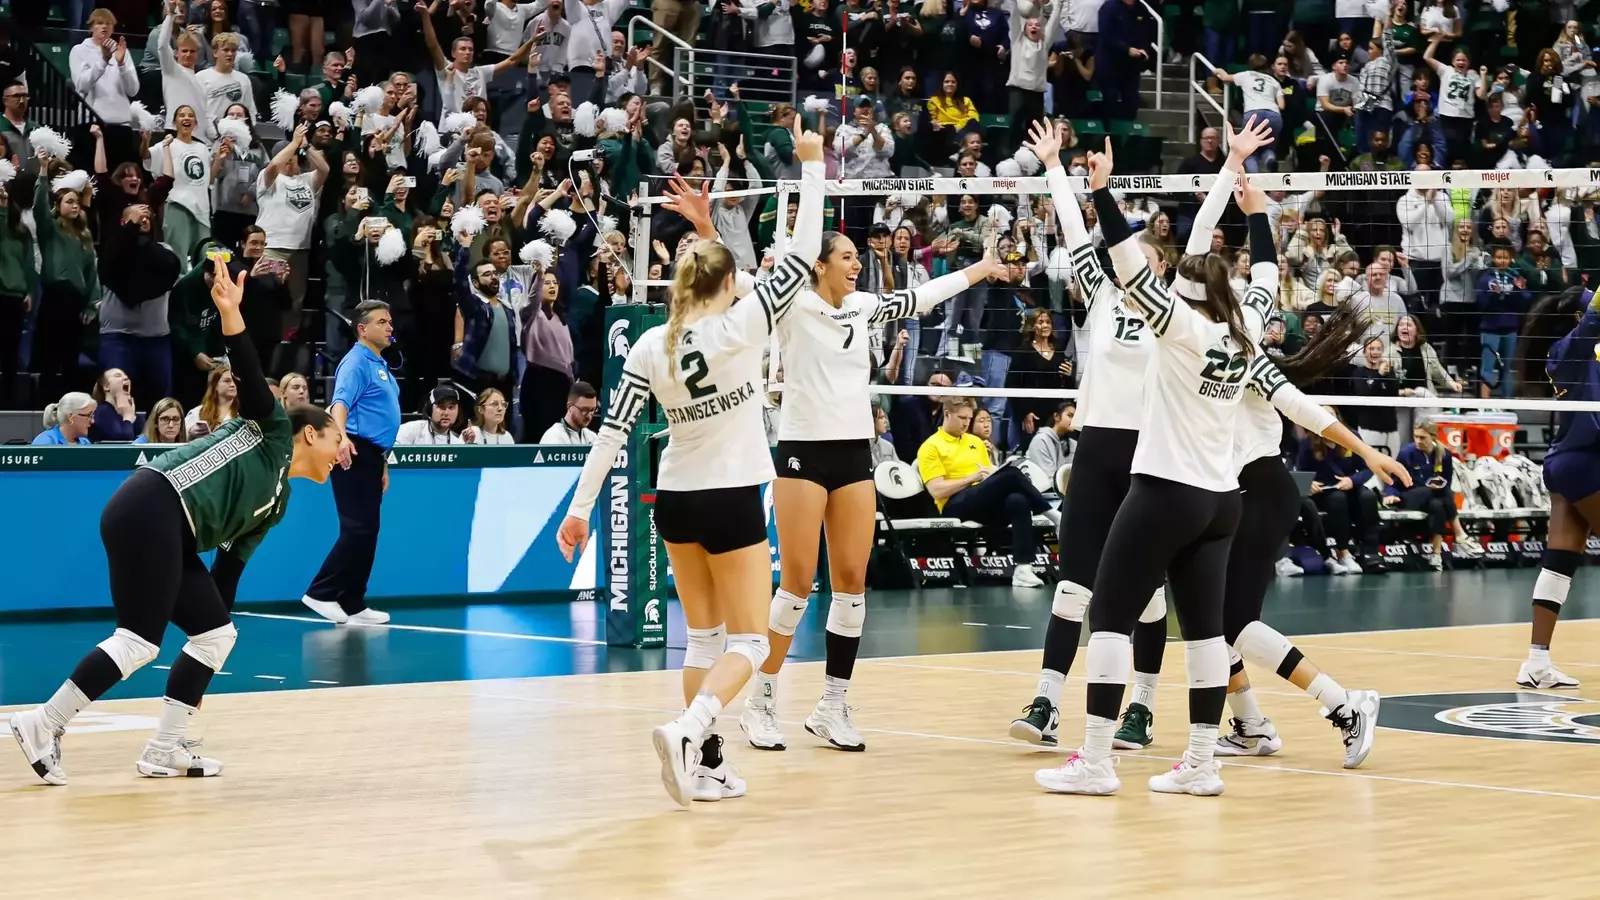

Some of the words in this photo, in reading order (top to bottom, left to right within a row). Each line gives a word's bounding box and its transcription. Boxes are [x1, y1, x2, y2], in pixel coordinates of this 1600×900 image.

[1253, 78, 1265, 92] 3
[1447, 81, 1470, 102] 24
[862, 179, 907, 191] MICHIGAN
[907, 179, 934, 191] STATE
[992, 179, 1016, 189] meijer
[1133, 176, 1162, 189] STATE
[1325, 173, 1378, 186] MICHIGAN
[1380, 172, 1412, 185] STATE
[1481, 173, 1510, 182] meijer
[840, 323, 854, 350] 7
[1114, 316, 1145, 341] 12
[681, 350, 718, 400] 2
[1198, 381, 1240, 400] BISHOP
[667, 382, 755, 424] STANISZEWSKA
[610, 475, 629, 613] MICHIGAN
[648, 546, 658, 591] imports
[922, 569, 950, 579] Mortgage
